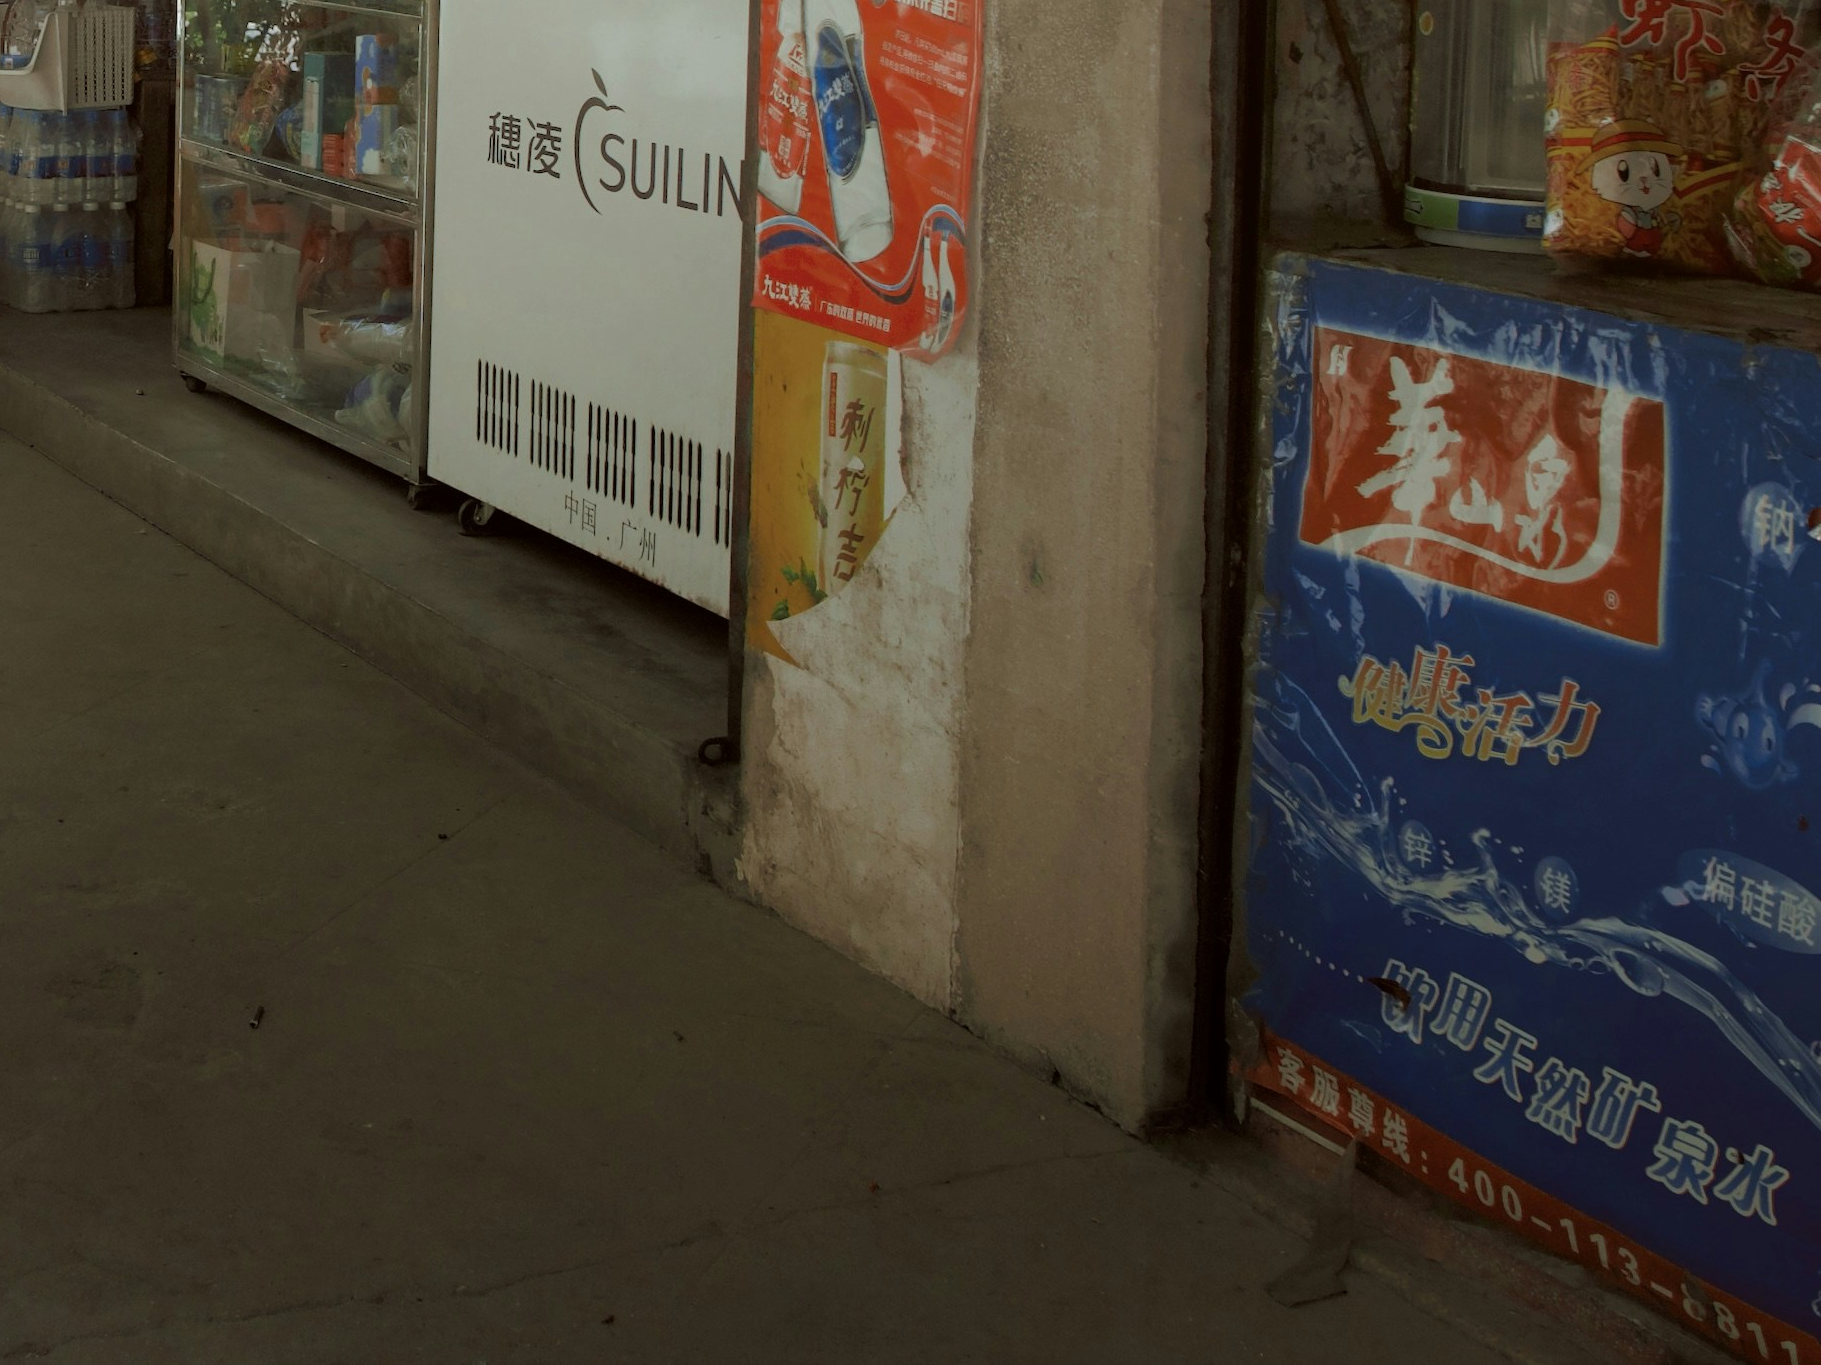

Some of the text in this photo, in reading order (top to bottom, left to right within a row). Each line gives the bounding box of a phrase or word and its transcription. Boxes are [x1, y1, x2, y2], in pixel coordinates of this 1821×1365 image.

[487, 111, 562, 179] 穗凌
[762, 274, 812, 311] 九江雙蒸
[833, 398, 876, 582] 刺柠吉
[1755, 493, 1794, 555] 钠
[1339, 642, 1602, 767] 健康活力
[1404, 830, 1433, 868] 锌
[1540, 865, 1572, 915] 镁
[1701, 855, 1820, 948] 偏硅酸
[1380, 959, 1791, 1227] 饮用天然矿泉水
